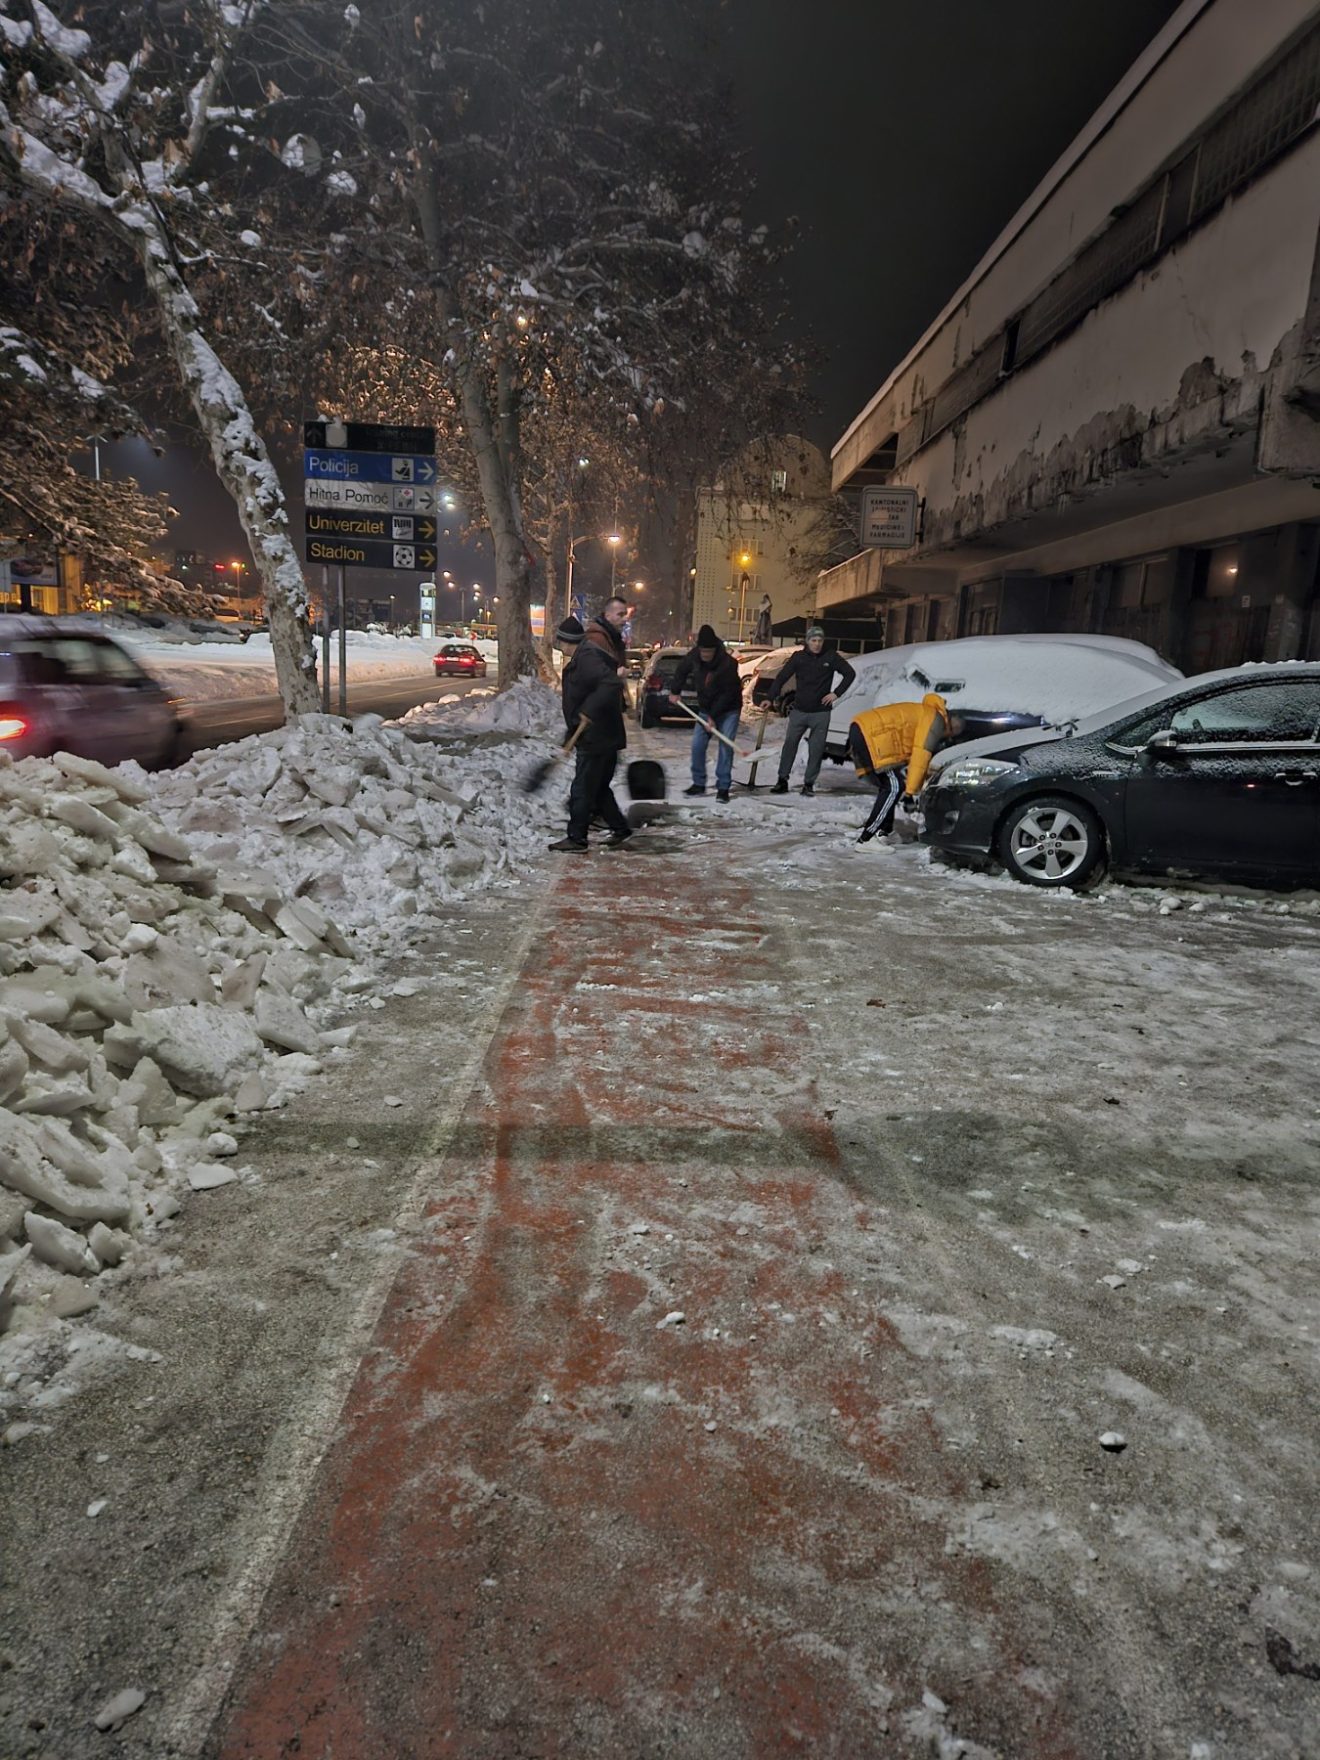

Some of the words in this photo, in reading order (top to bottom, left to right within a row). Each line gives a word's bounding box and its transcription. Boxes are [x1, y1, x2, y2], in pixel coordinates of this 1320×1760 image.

[309, 457, 359, 477] Policija
[309, 487, 340, 501] Hitna
[345, 489, 389, 505] Pomoć
[309, 515, 385, 534] Univerzitet
[310, 542, 365, 561] Stadion
